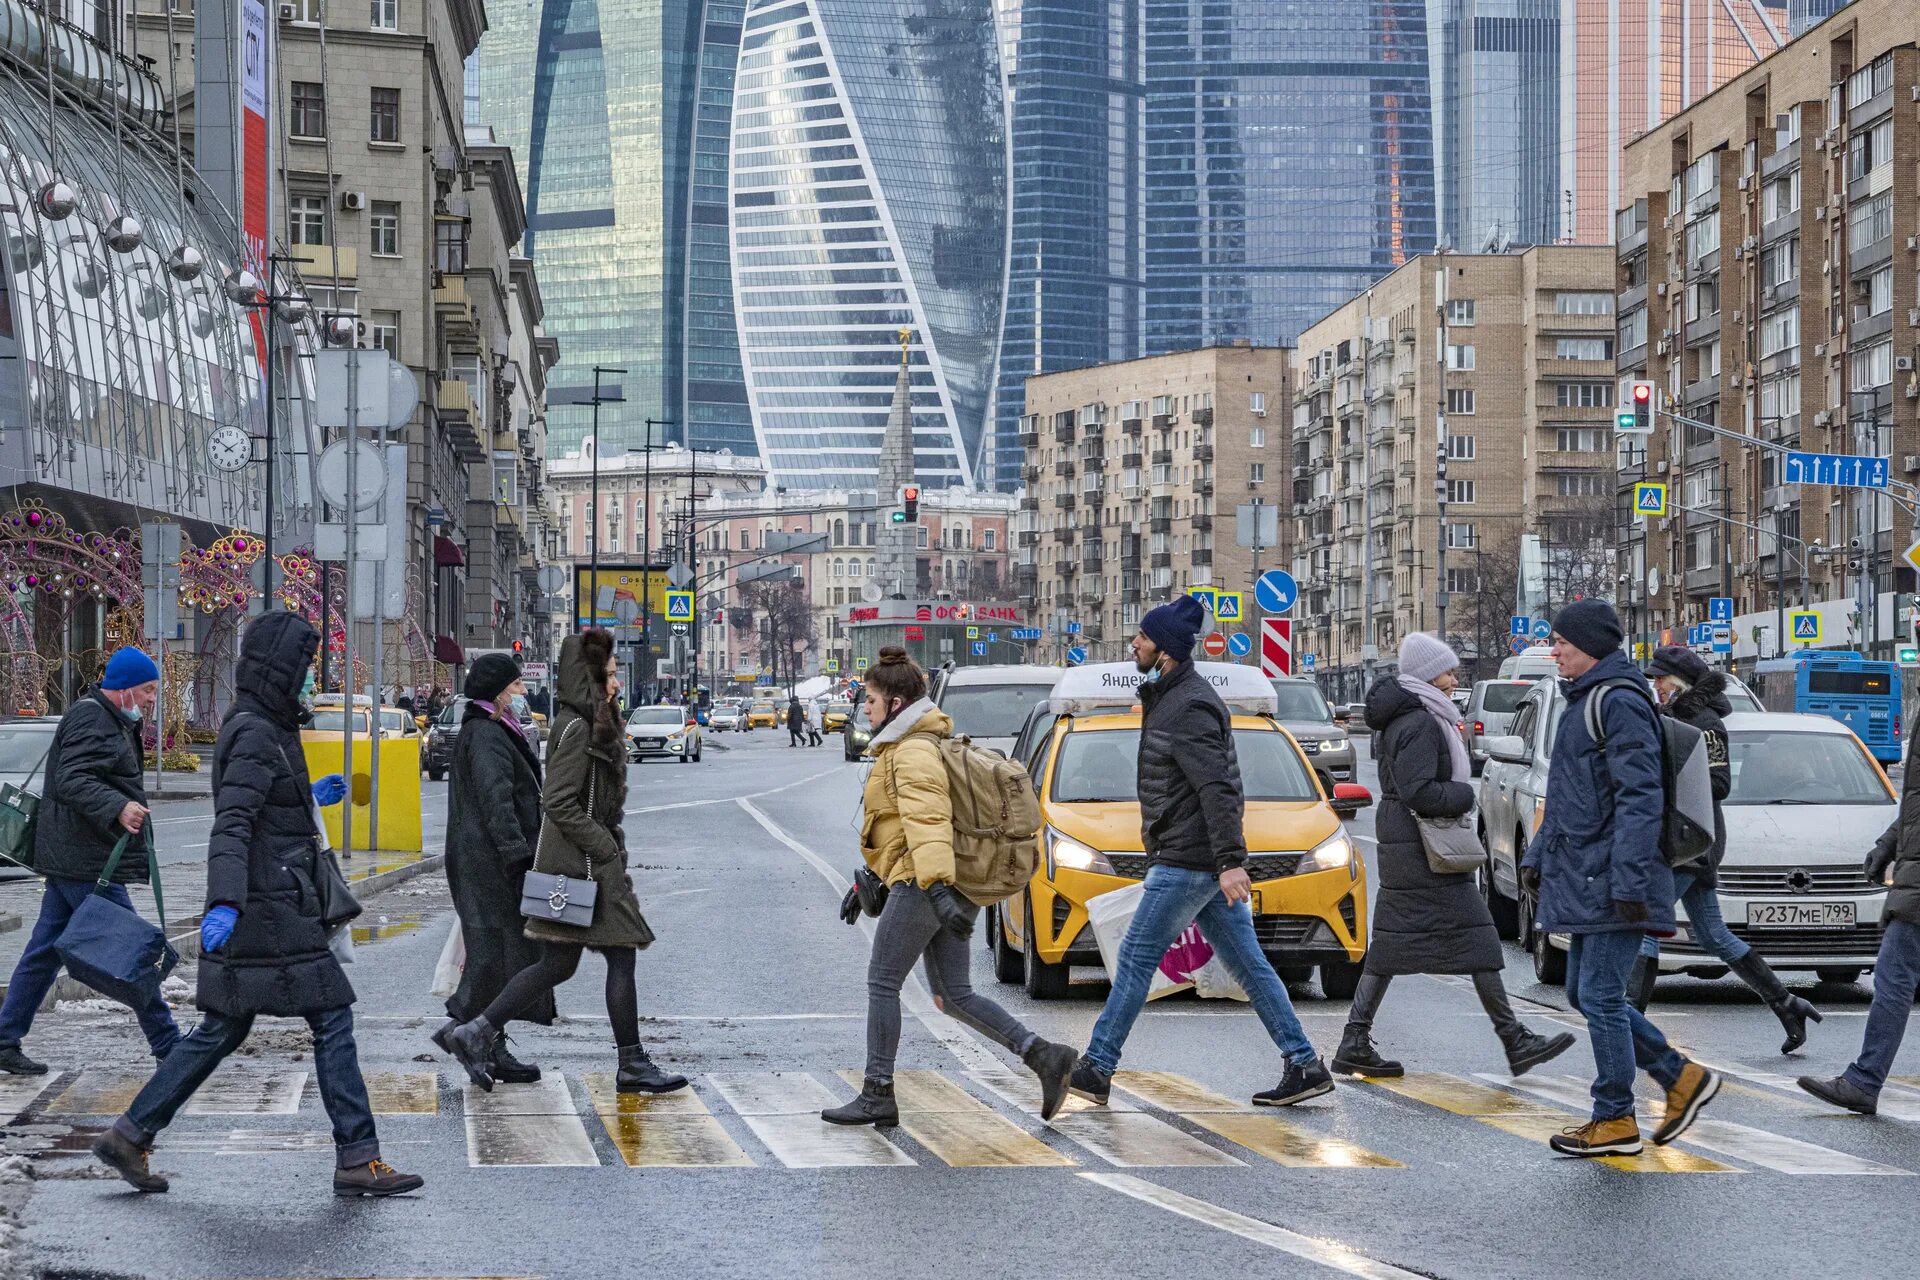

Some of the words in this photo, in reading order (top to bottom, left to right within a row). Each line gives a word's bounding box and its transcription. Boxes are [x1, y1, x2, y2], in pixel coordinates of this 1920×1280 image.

[936, 605, 1018, 621] ФОБАНК
[1702, 625, 1712, 640] P
[1306, 655, 1314, 665] P
[1101, 673, 1147, 688] Яндек
[1204, 675, 1229, 687] кси
[1754, 906, 1821, 923] У237МЕ
[1824, 904, 1850, 918] 799
